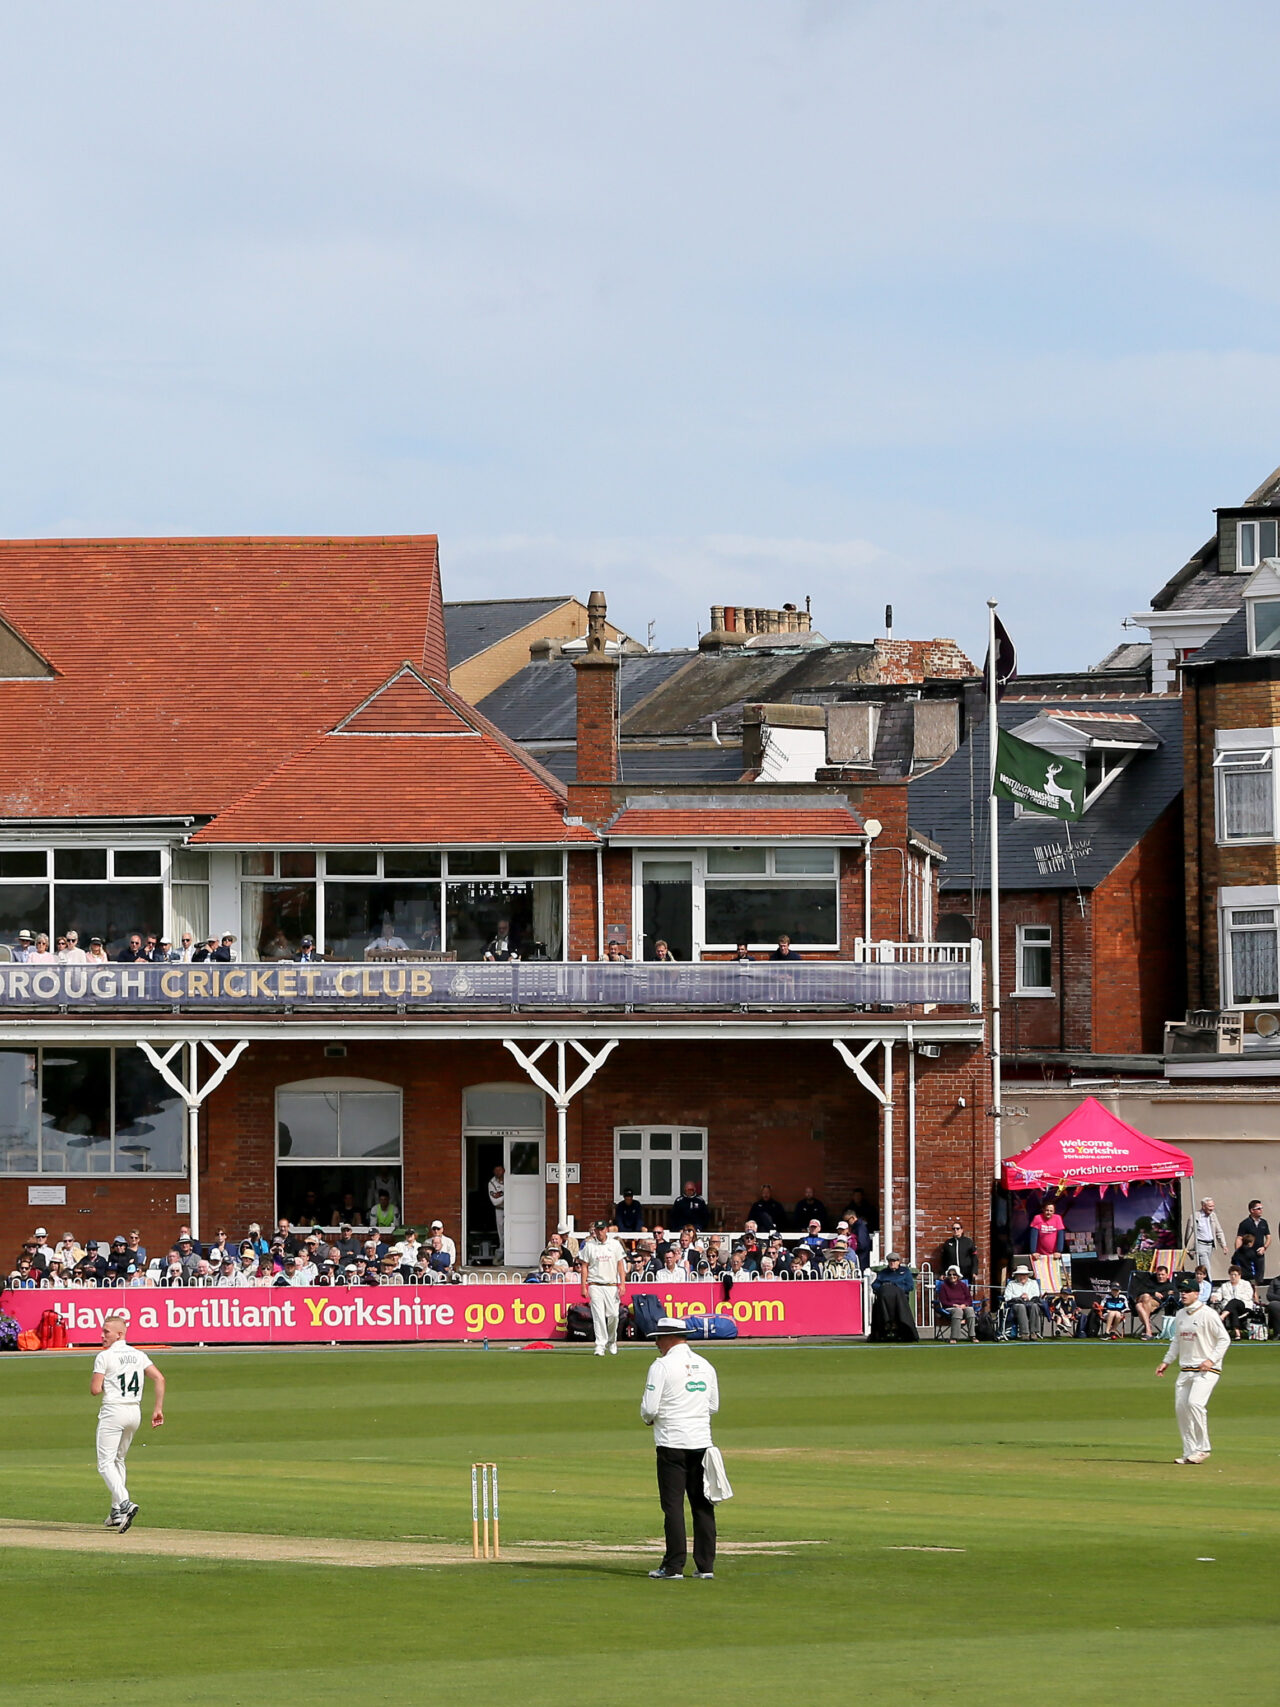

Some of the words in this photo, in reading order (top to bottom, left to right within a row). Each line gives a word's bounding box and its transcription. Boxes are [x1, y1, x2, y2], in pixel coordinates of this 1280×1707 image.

[160, 970, 322, 998] CRICKET
[334, 970, 433, 998] CLUB
[1059, 1139, 1114, 1147] Welcome
[1076, 1146, 1130, 1155] Yorkshire
[1062, 1163, 1139, 1178] yorkshire.com
[53, 1302, 131, 1329] Have
[139, 1306, 160, 1329] a
[165, 1298, 296, 1328] brilliant
[303, 1296, 455, 1326] Yorkshire
[464, 1303, 505, 1333] go
[512, 1298, 546, 1325] to
[118, 1354, 138, 1365] WOOD
[117, 1370, 140, 1398] 14
